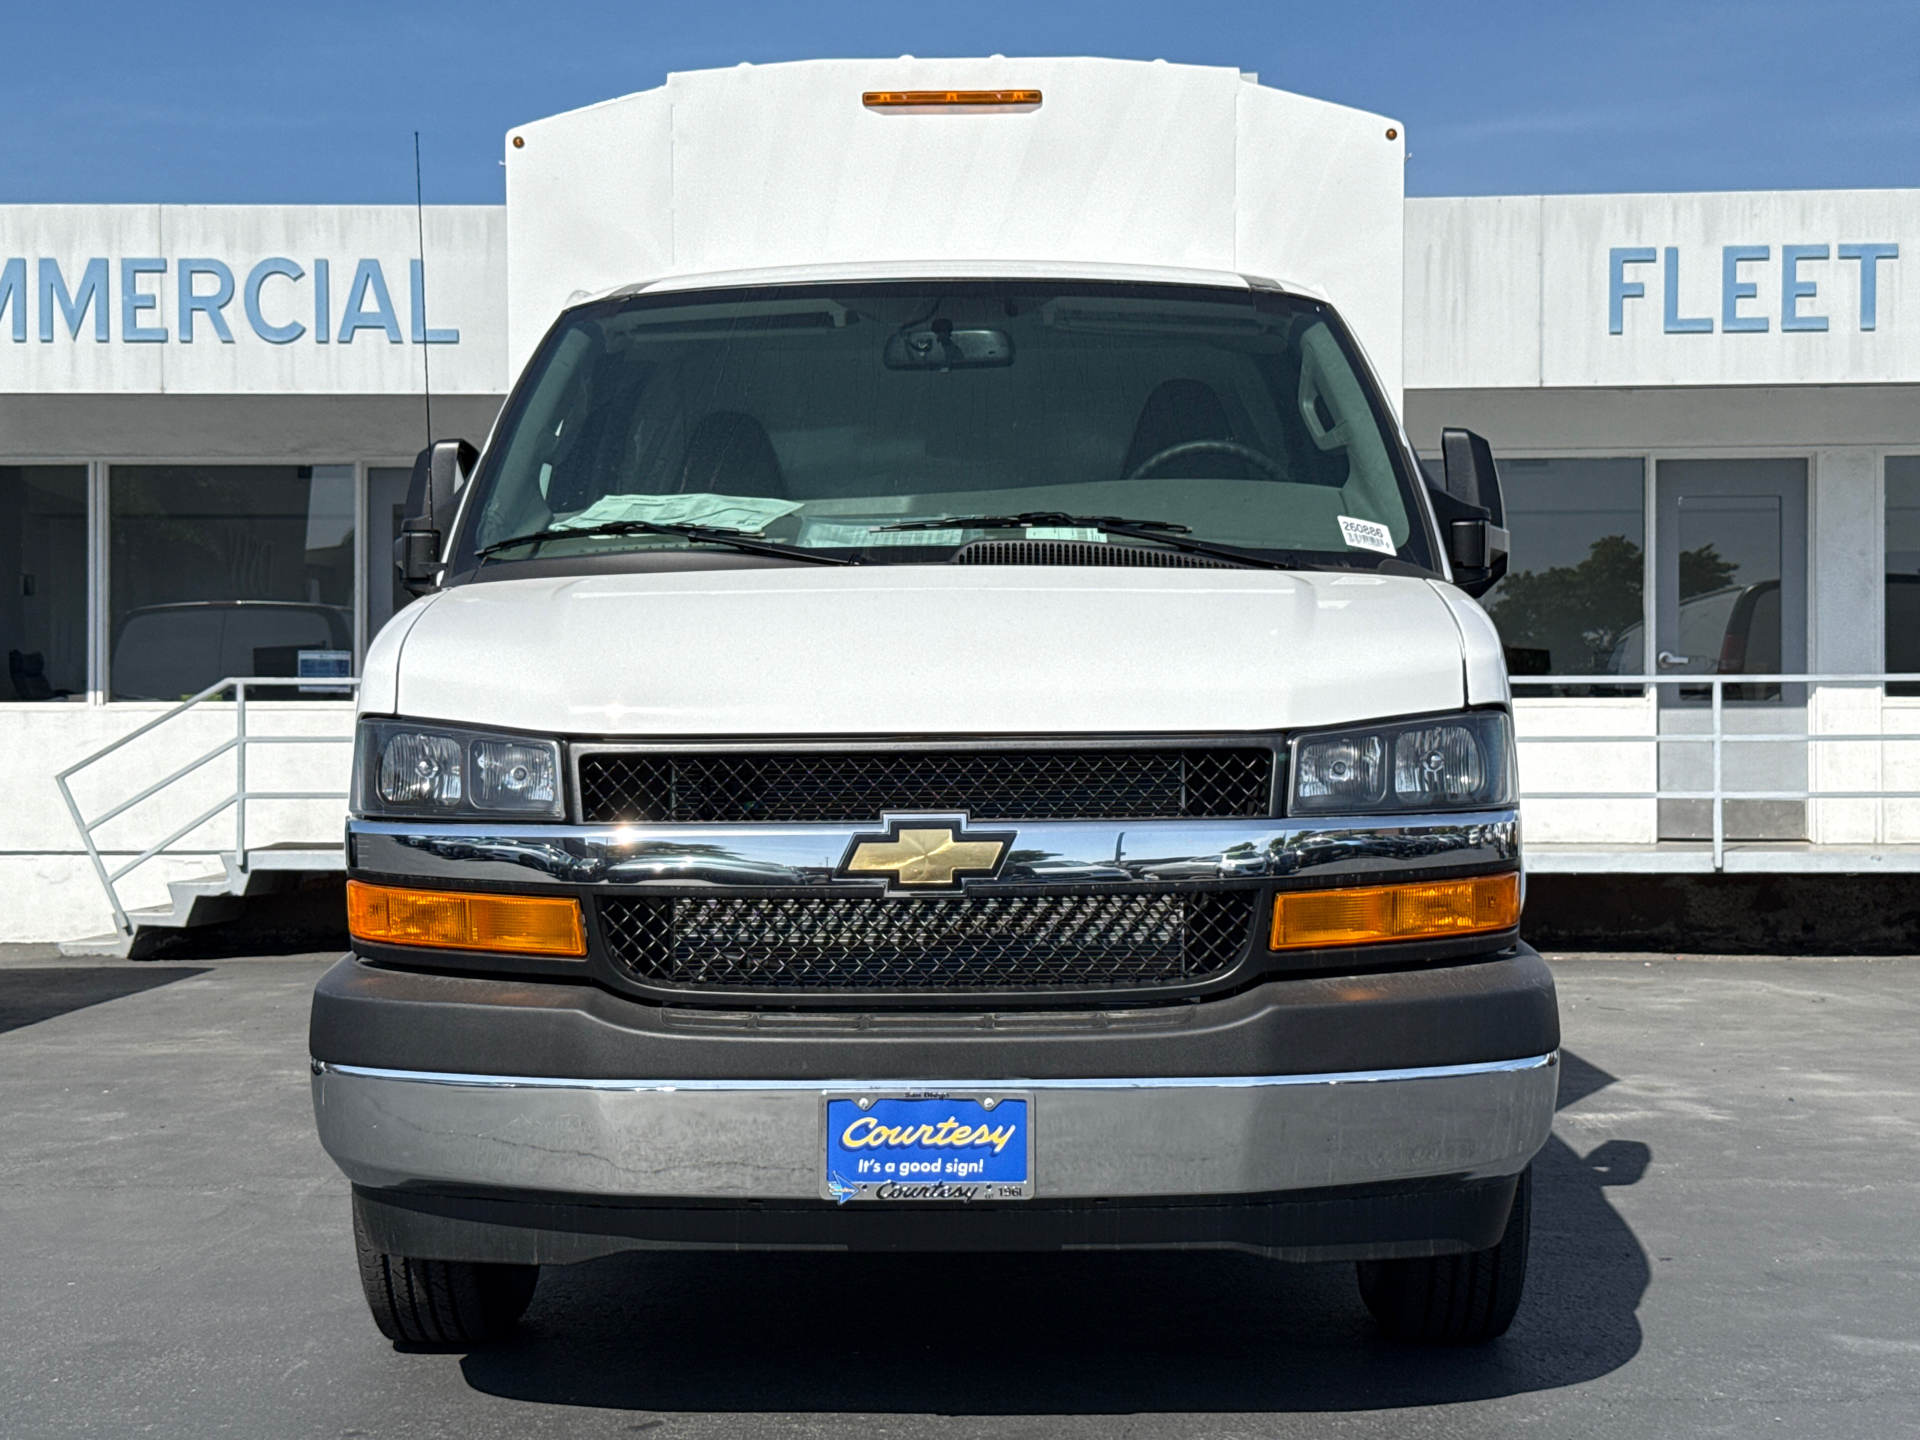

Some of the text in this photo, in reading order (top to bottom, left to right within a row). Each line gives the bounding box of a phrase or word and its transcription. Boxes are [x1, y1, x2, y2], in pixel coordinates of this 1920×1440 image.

[1608, 243, 1899, 336] FLEET
[1342, 521, 1384, 538] 260886
[841, 1116, 1016, 1155] Courtesy
[858, 1158, 984, 1176] It's a good sign!
[876, 1181, 978, 1203] Courtesy
[998, 1187, 1022, 1197] 1961
